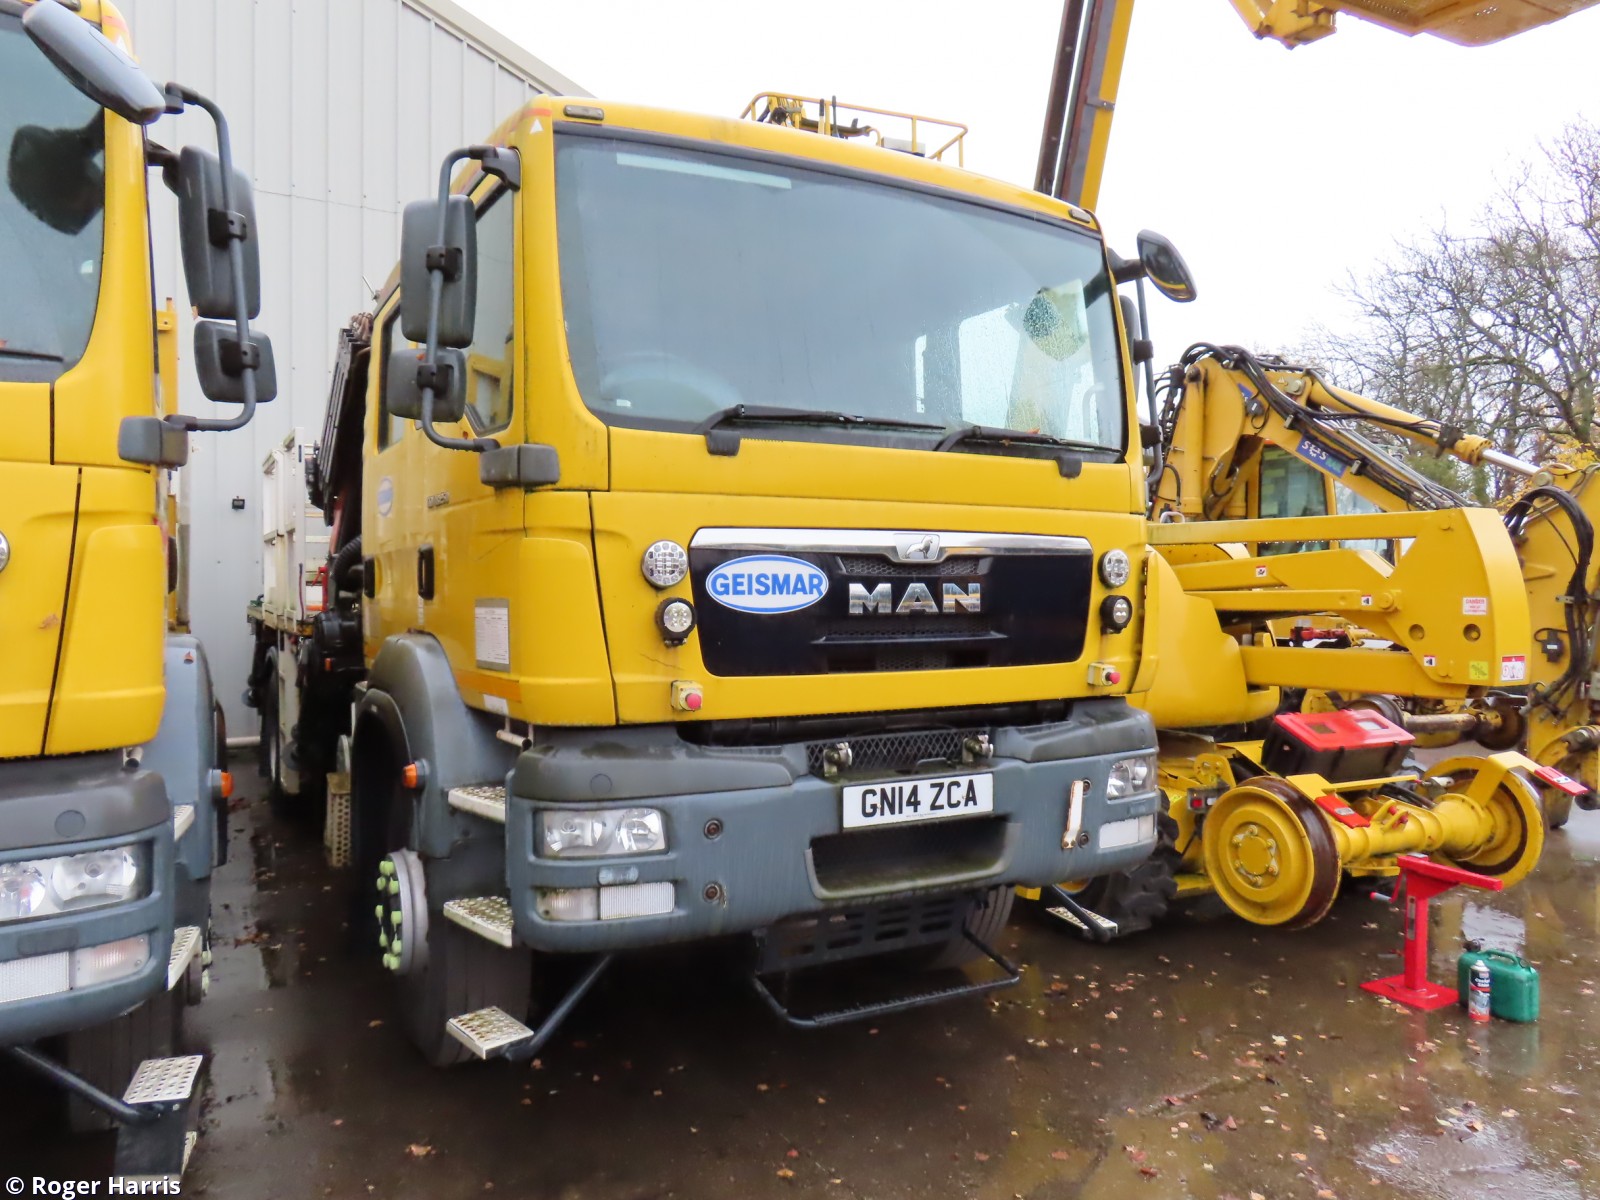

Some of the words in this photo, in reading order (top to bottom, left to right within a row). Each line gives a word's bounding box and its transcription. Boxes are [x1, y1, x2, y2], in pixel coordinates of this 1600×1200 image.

[711, 573, 823, 598] GEISMAR
[849, 582, 981, 615] MAN
[861, 784, 921, 818] GN14
[929, 779, 978, 811] ZCA
